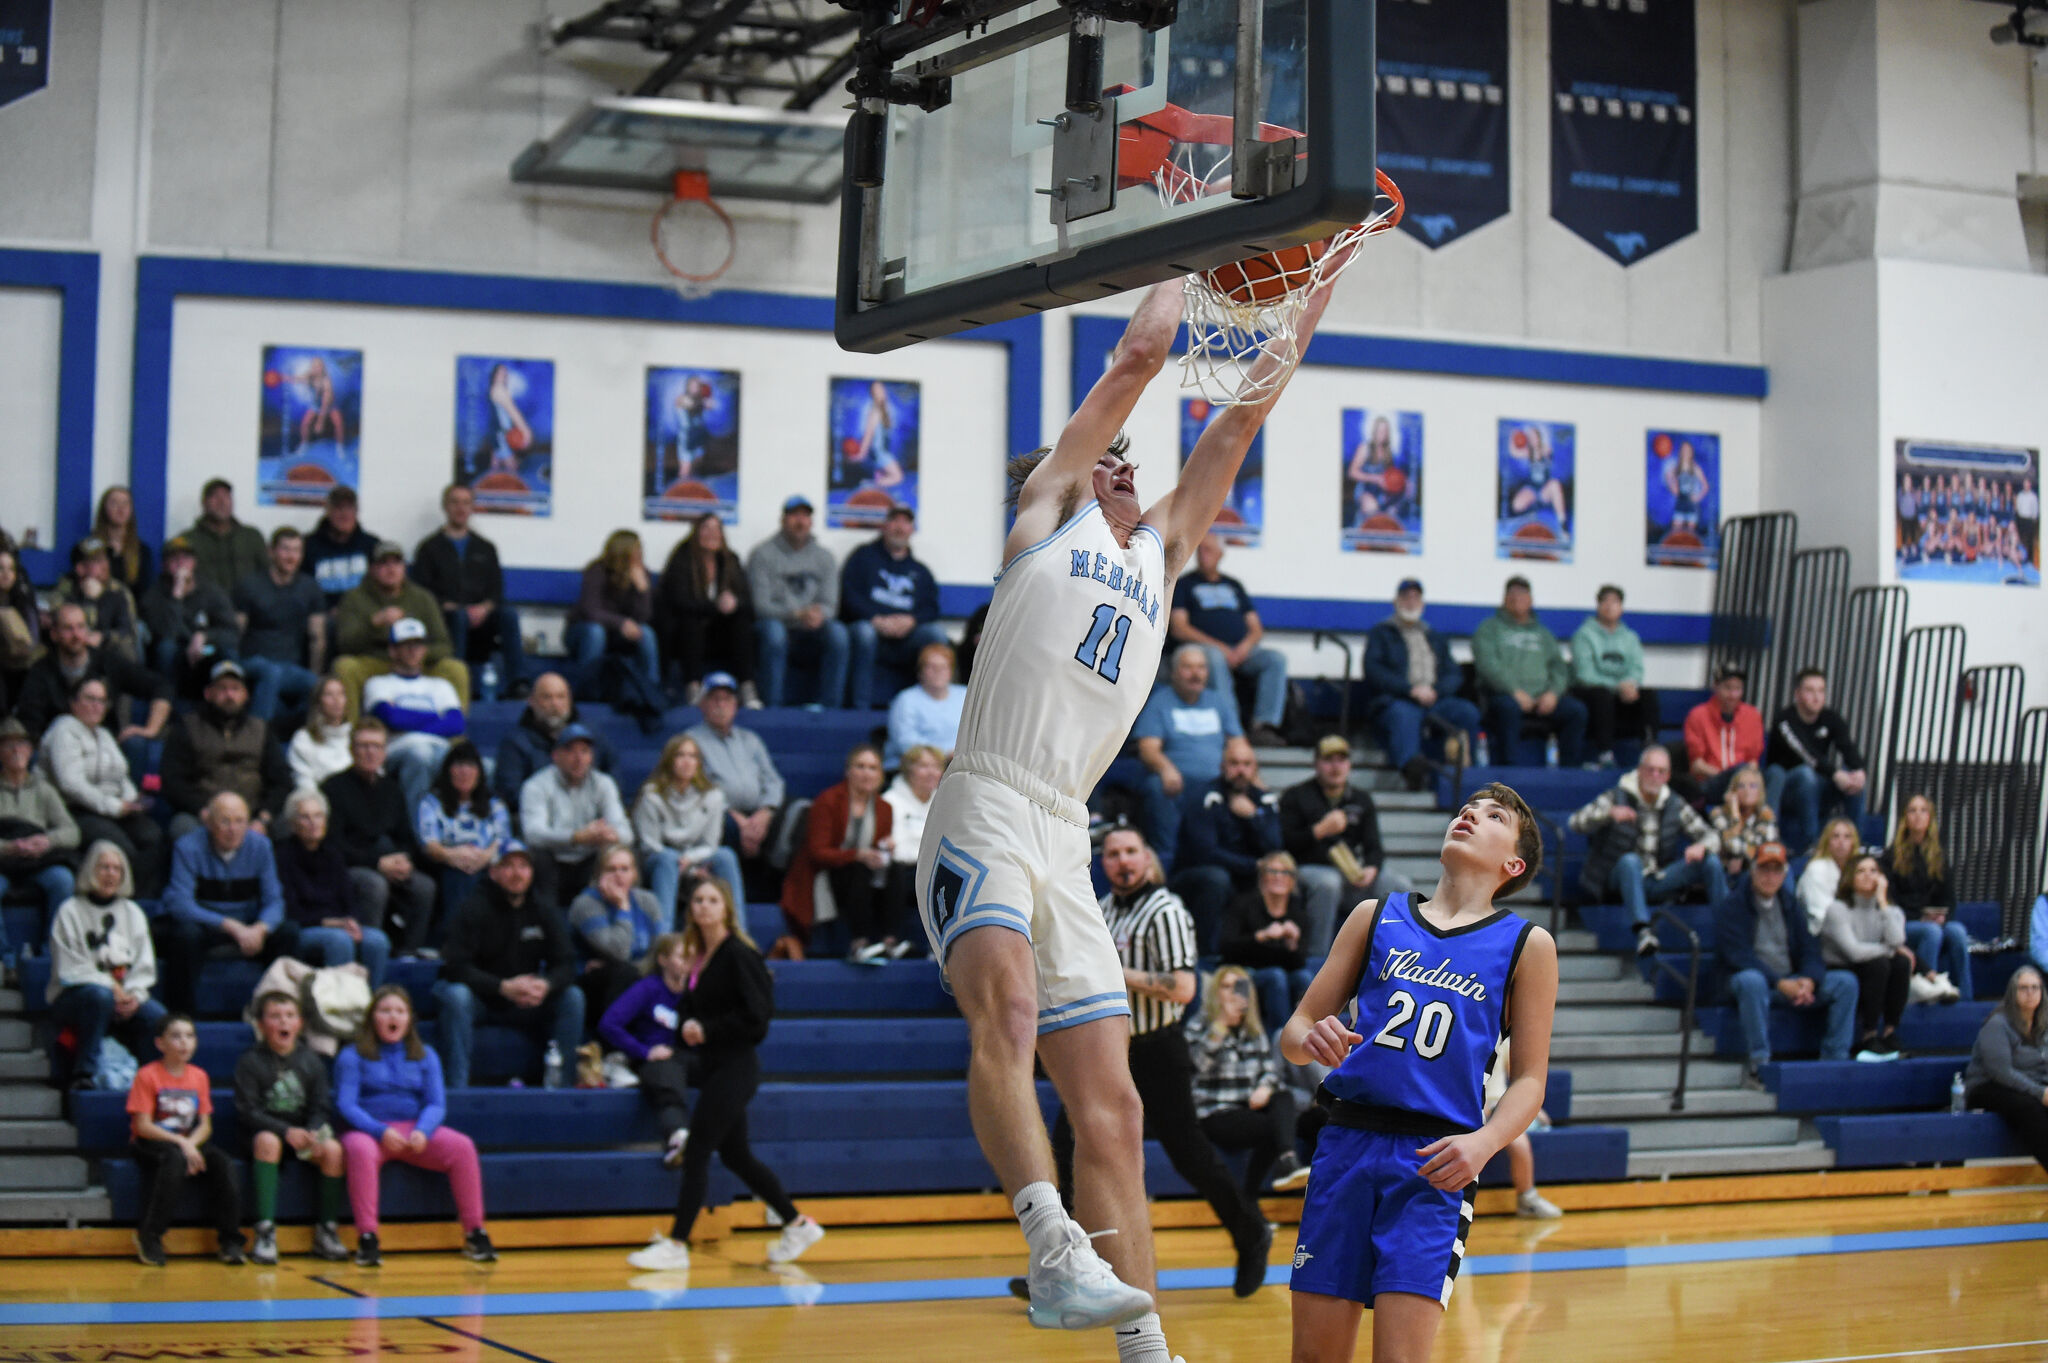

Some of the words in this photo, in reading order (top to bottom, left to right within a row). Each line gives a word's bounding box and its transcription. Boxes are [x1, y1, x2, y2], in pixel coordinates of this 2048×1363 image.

[1070, 549, 1159, 630] MERIIAN
[1074, 603, 1132, 685] 11
[1374, 990, 1455, 1061] 20
